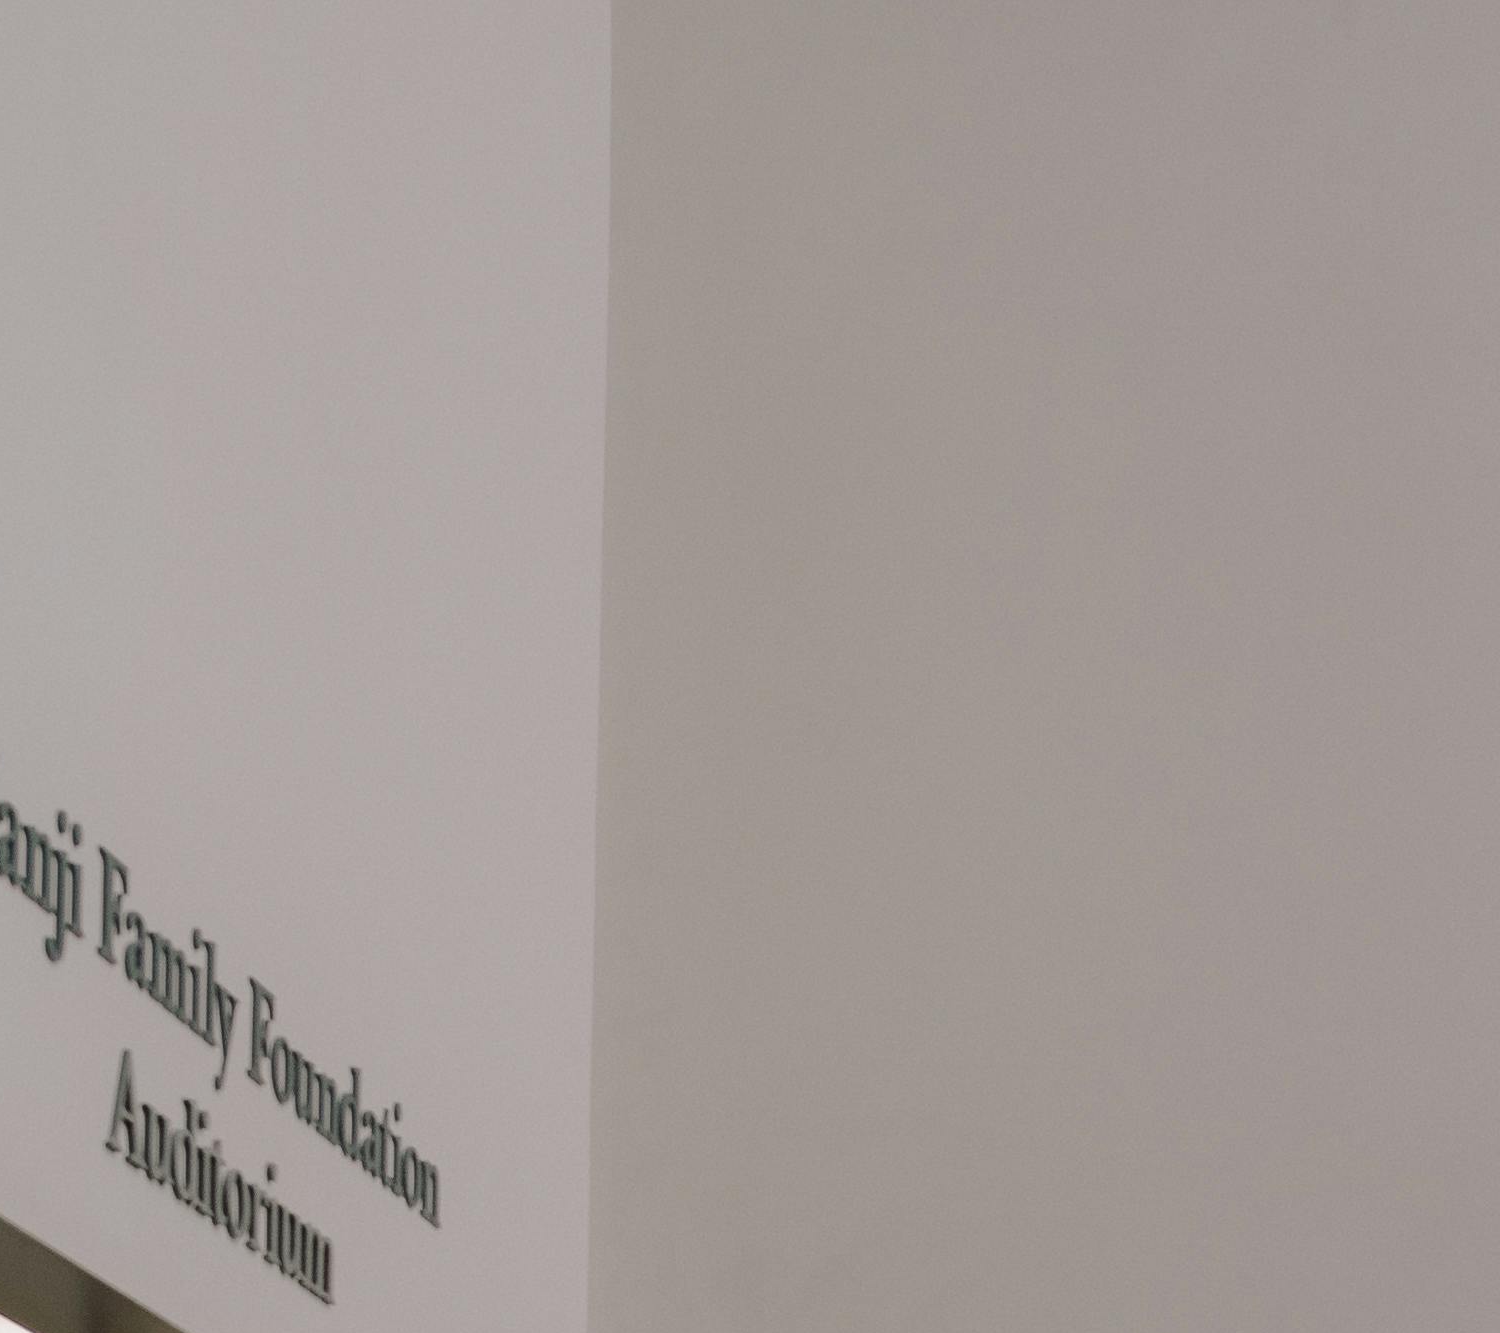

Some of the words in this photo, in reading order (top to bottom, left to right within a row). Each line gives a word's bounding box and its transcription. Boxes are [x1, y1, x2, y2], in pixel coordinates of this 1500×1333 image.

[97, 846, 240, 1090] Family
[247, 977, 442, 1229] Foundation
[105, 1049, 336, 1305] Auditorium
